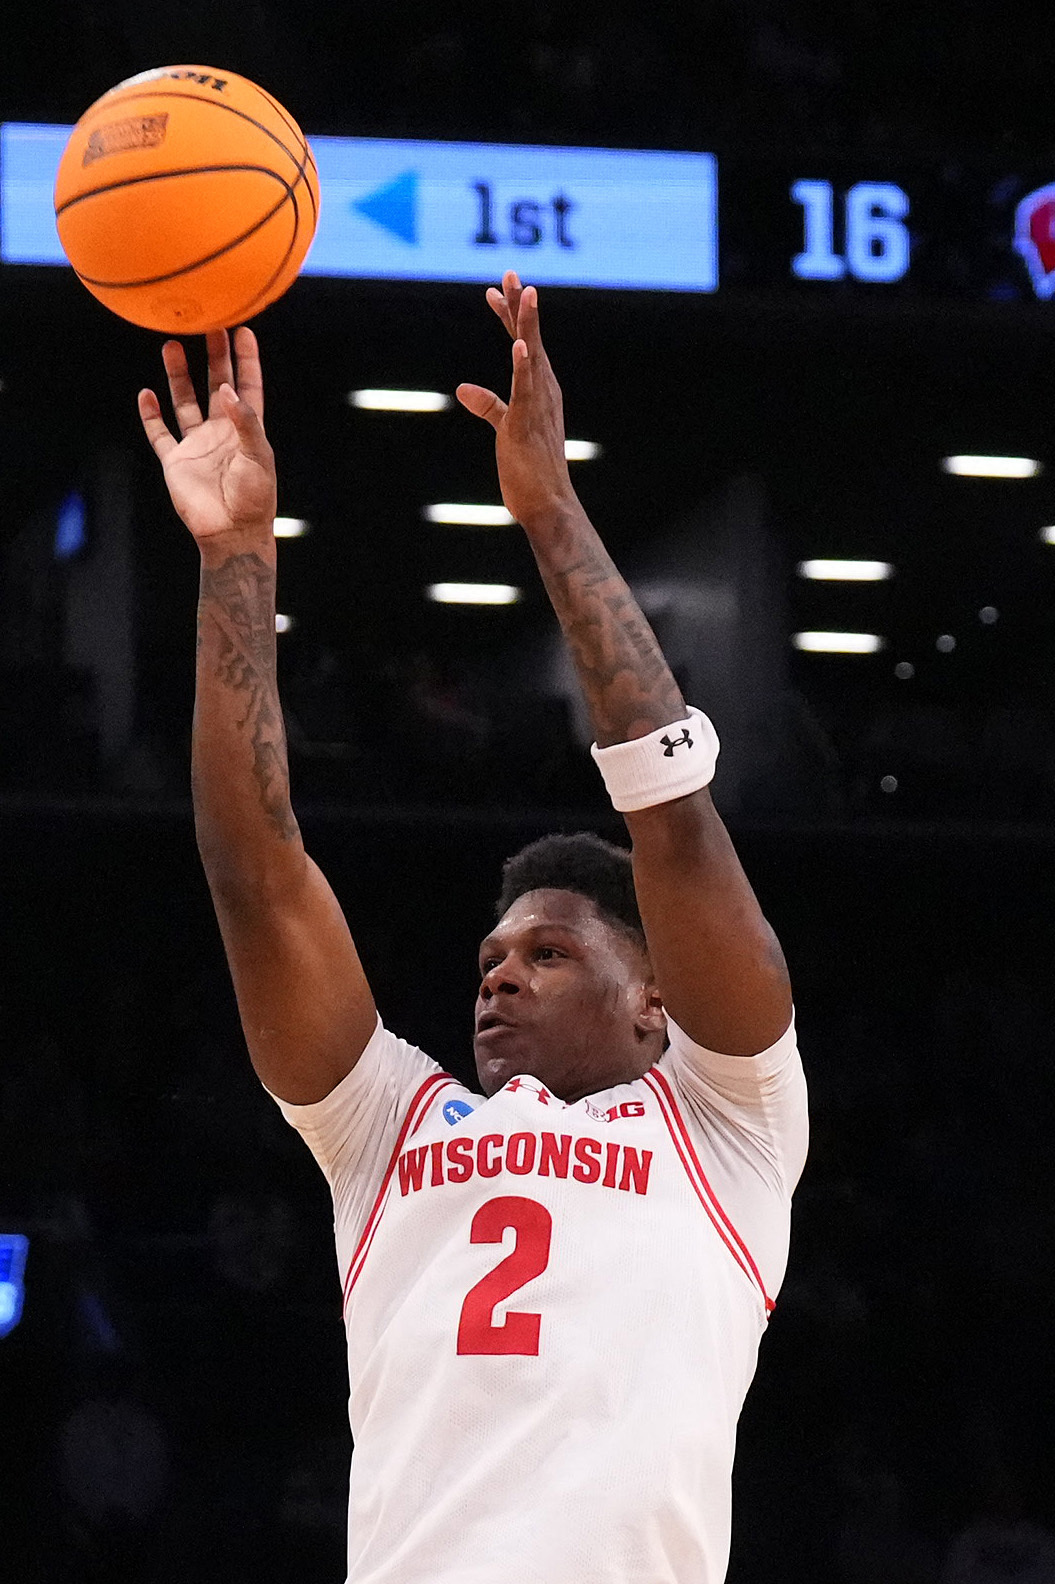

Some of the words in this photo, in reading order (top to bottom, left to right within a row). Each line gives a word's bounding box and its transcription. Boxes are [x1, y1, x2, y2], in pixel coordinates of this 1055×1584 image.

[471, 177, 578, 251] 1st
[790, 177, 913, 284] 16
[398, 1131, 653, 1197] WISCONSIN
[456, 1196, 553, 1356] 2
